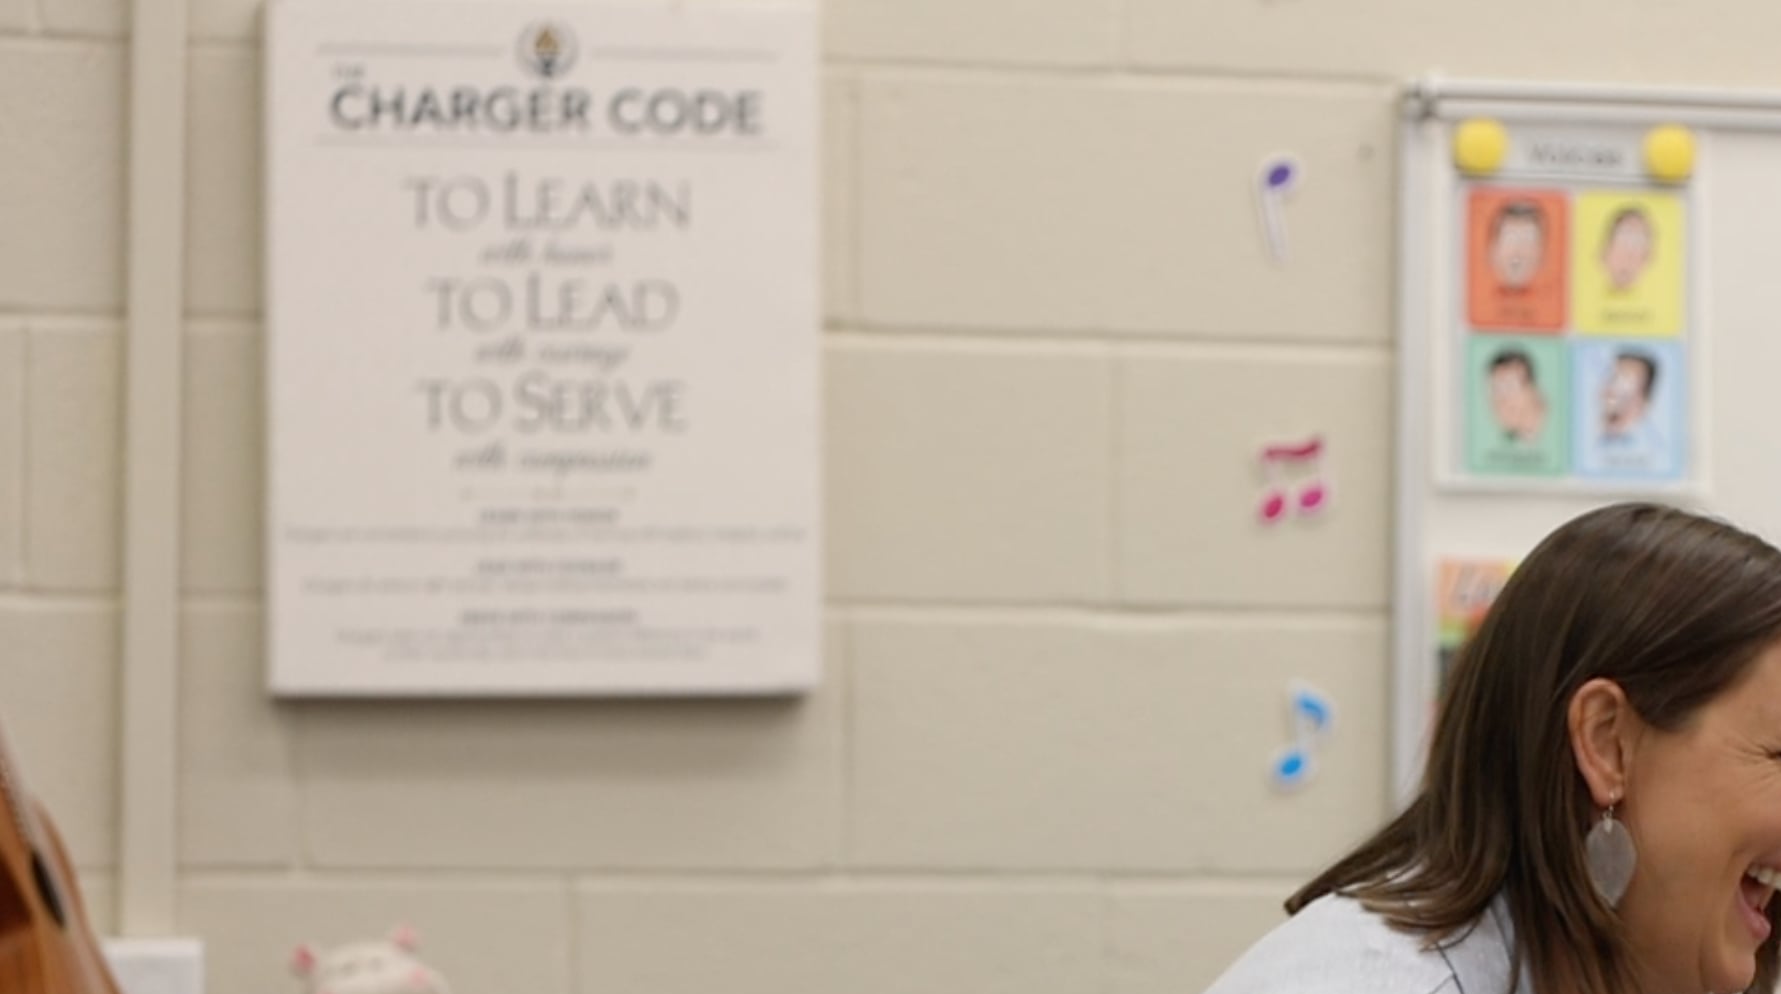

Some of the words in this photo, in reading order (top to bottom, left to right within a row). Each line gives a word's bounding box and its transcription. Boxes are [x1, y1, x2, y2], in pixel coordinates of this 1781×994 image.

[328, 84, 594, 134] CHARGER
[608, 88, 764, 136] CODE
[404, 176, 491, 232] TO
[503, 171, 693, 233] LEARN
[427, 276, 513, 334] TO
[525, 272, 682, 335] LEAD
[416, 376, 502, 434] TO
[513, 371, 688, 435] SERVE
